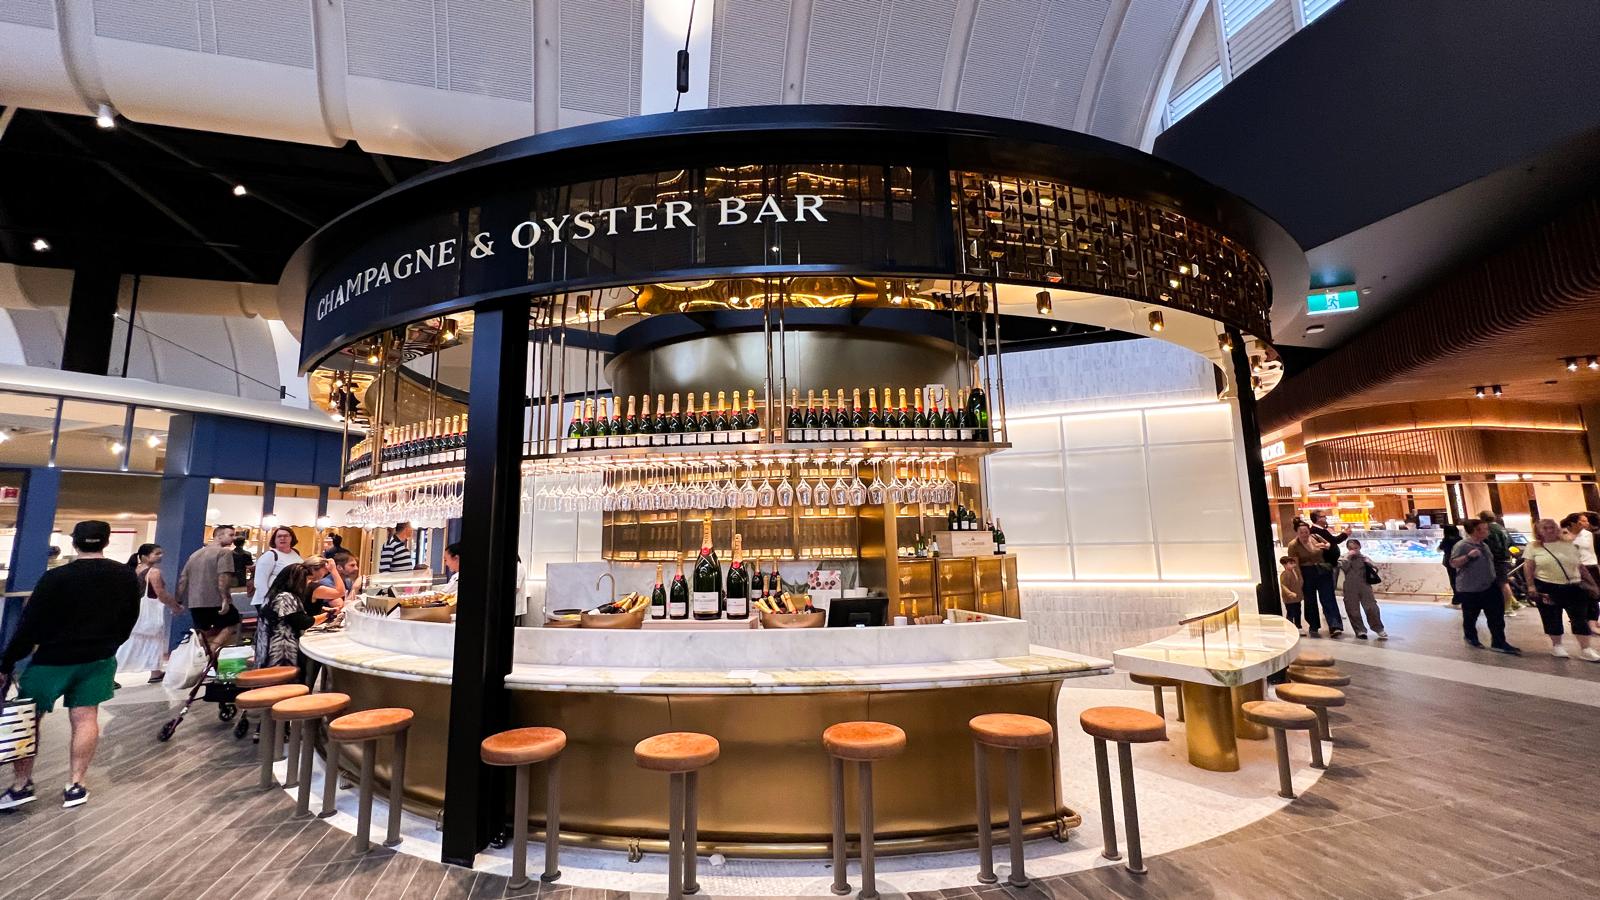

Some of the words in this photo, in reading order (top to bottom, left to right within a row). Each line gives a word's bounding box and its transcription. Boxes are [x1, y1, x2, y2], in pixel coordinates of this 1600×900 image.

[316, 238, 457, 321] CHAMPAGNE
[470, 232, 495, 259] &
[511, 200, 697, 250] OYSTER
[718, 193, 829, 226] BAR
